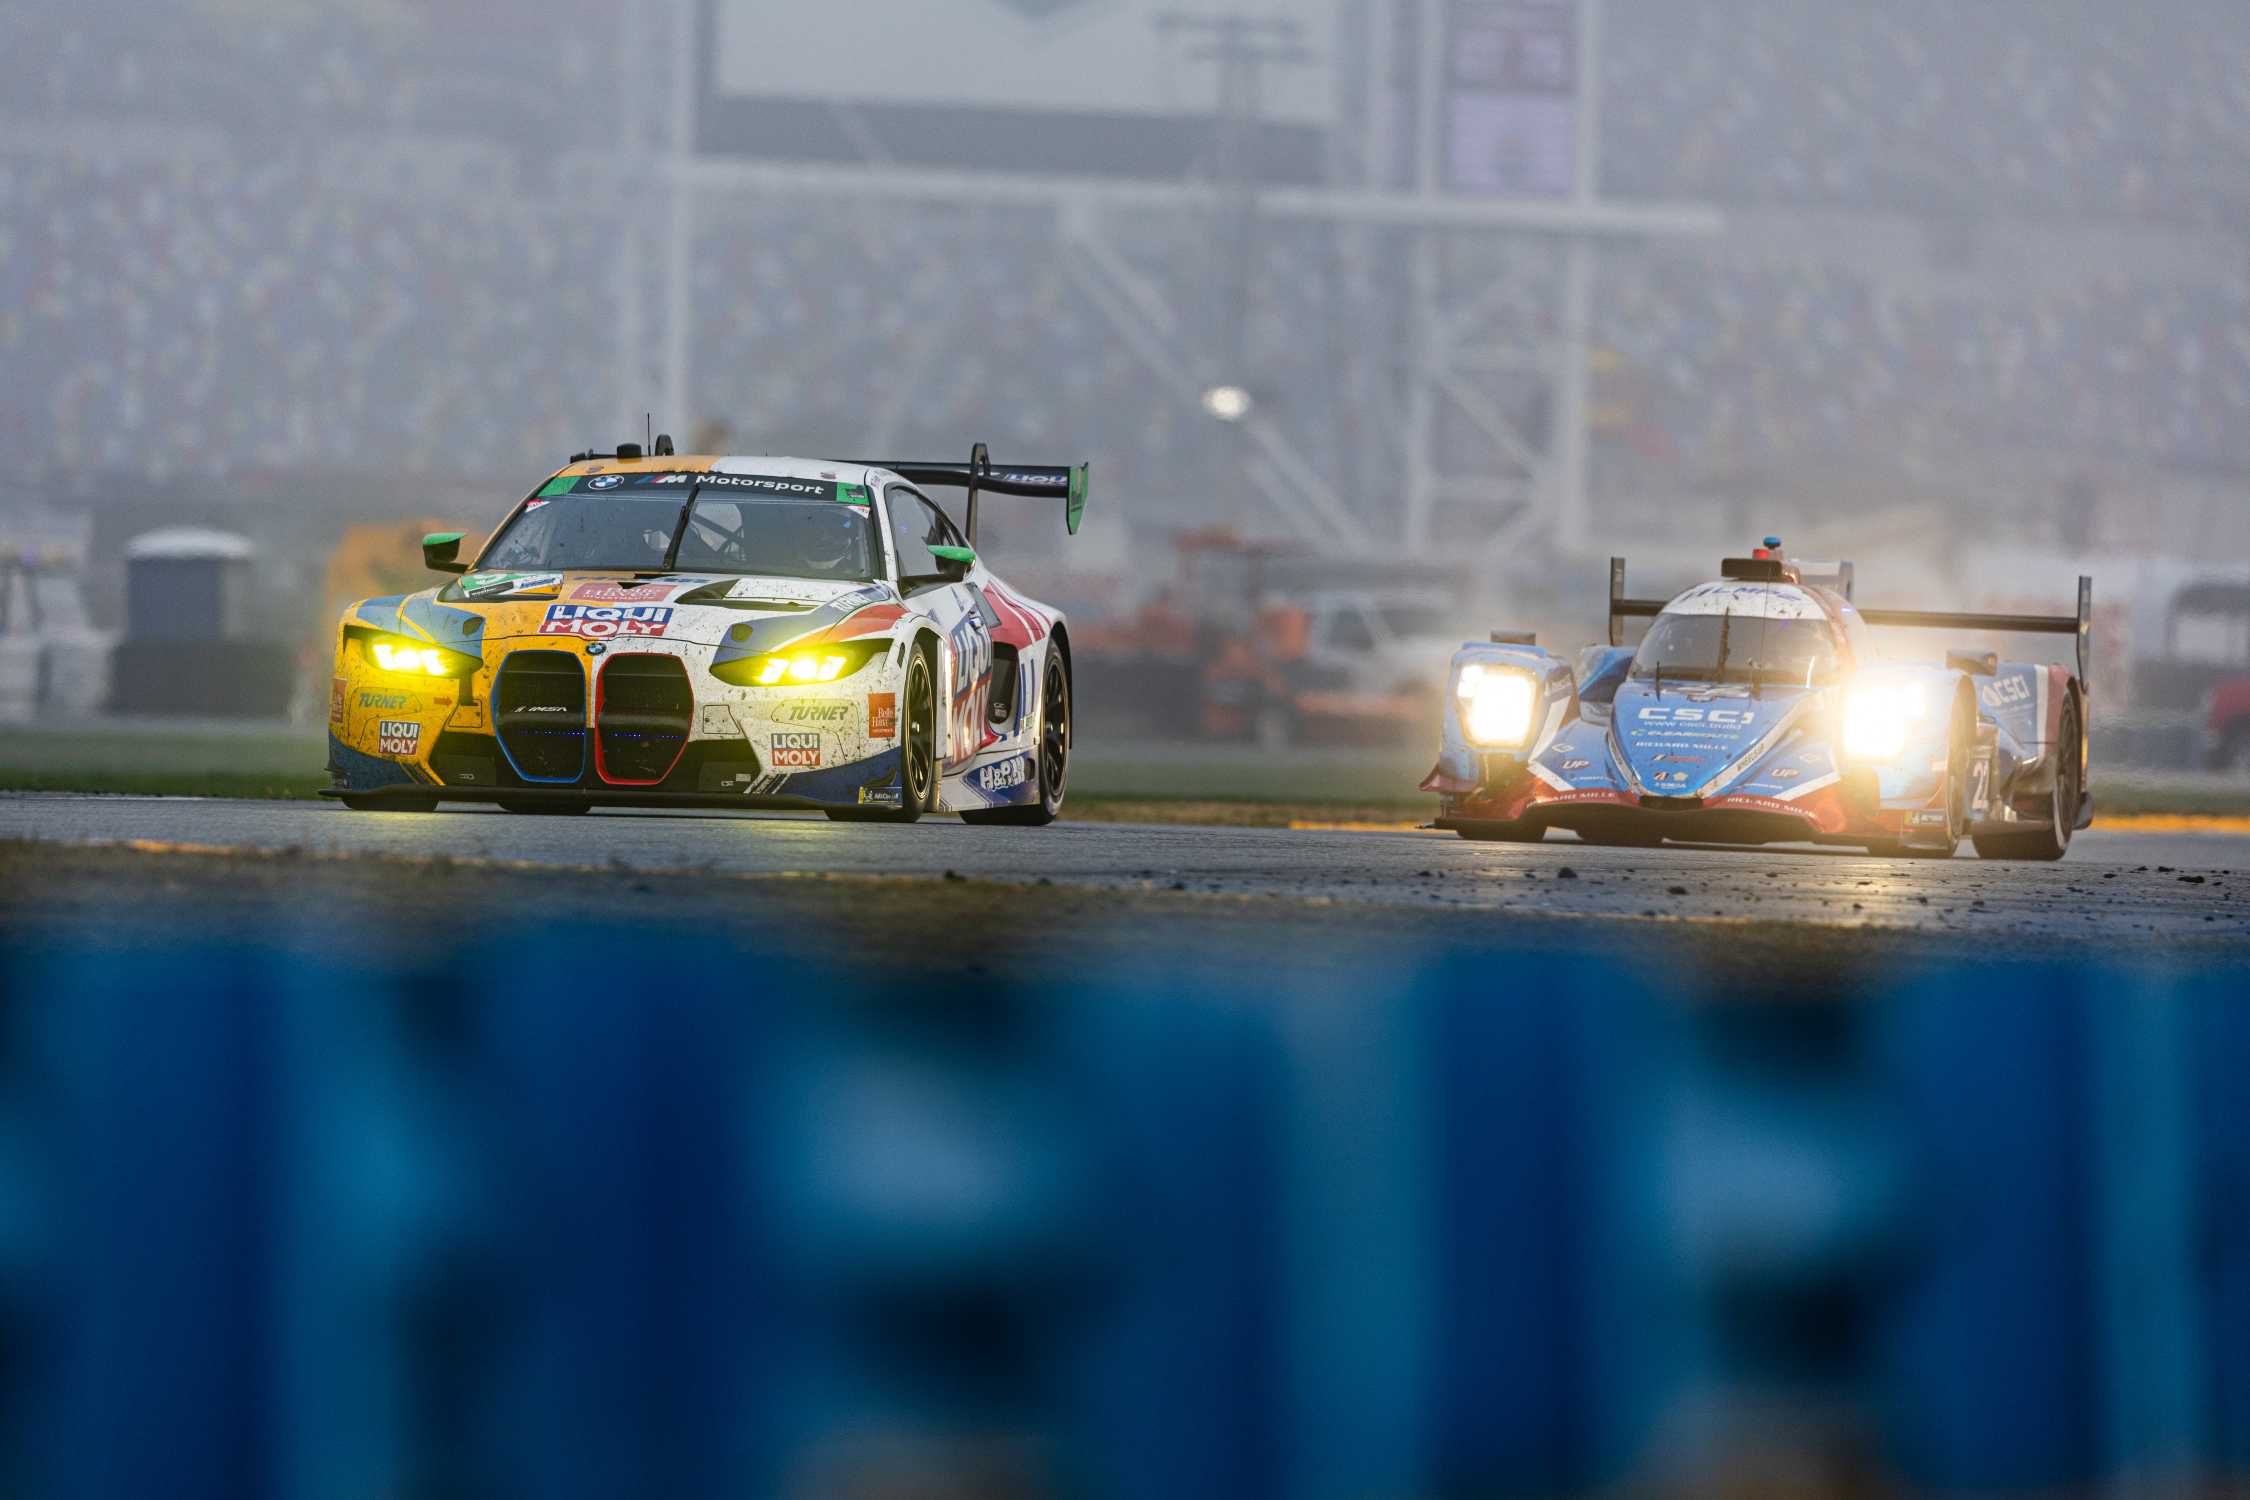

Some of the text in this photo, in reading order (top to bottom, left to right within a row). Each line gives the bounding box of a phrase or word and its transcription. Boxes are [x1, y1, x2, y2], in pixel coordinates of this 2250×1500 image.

[696, 475, 824, 494] Motorsport
[553, 606, 667, 621] LIQUI
[546, 619, 664, 636] MOLY
[1993, 675, 2031, 704] CSCI
[359, 692, 407, 710] TURNER
[788, 706, 849, 721] TURNER
[381, 722, 419, 738] LIQUI
[380, 738, 417, 754] MOLY
[773, 734, 818, 749] LIQUI
[774, 750, 819, 765] MOLY
